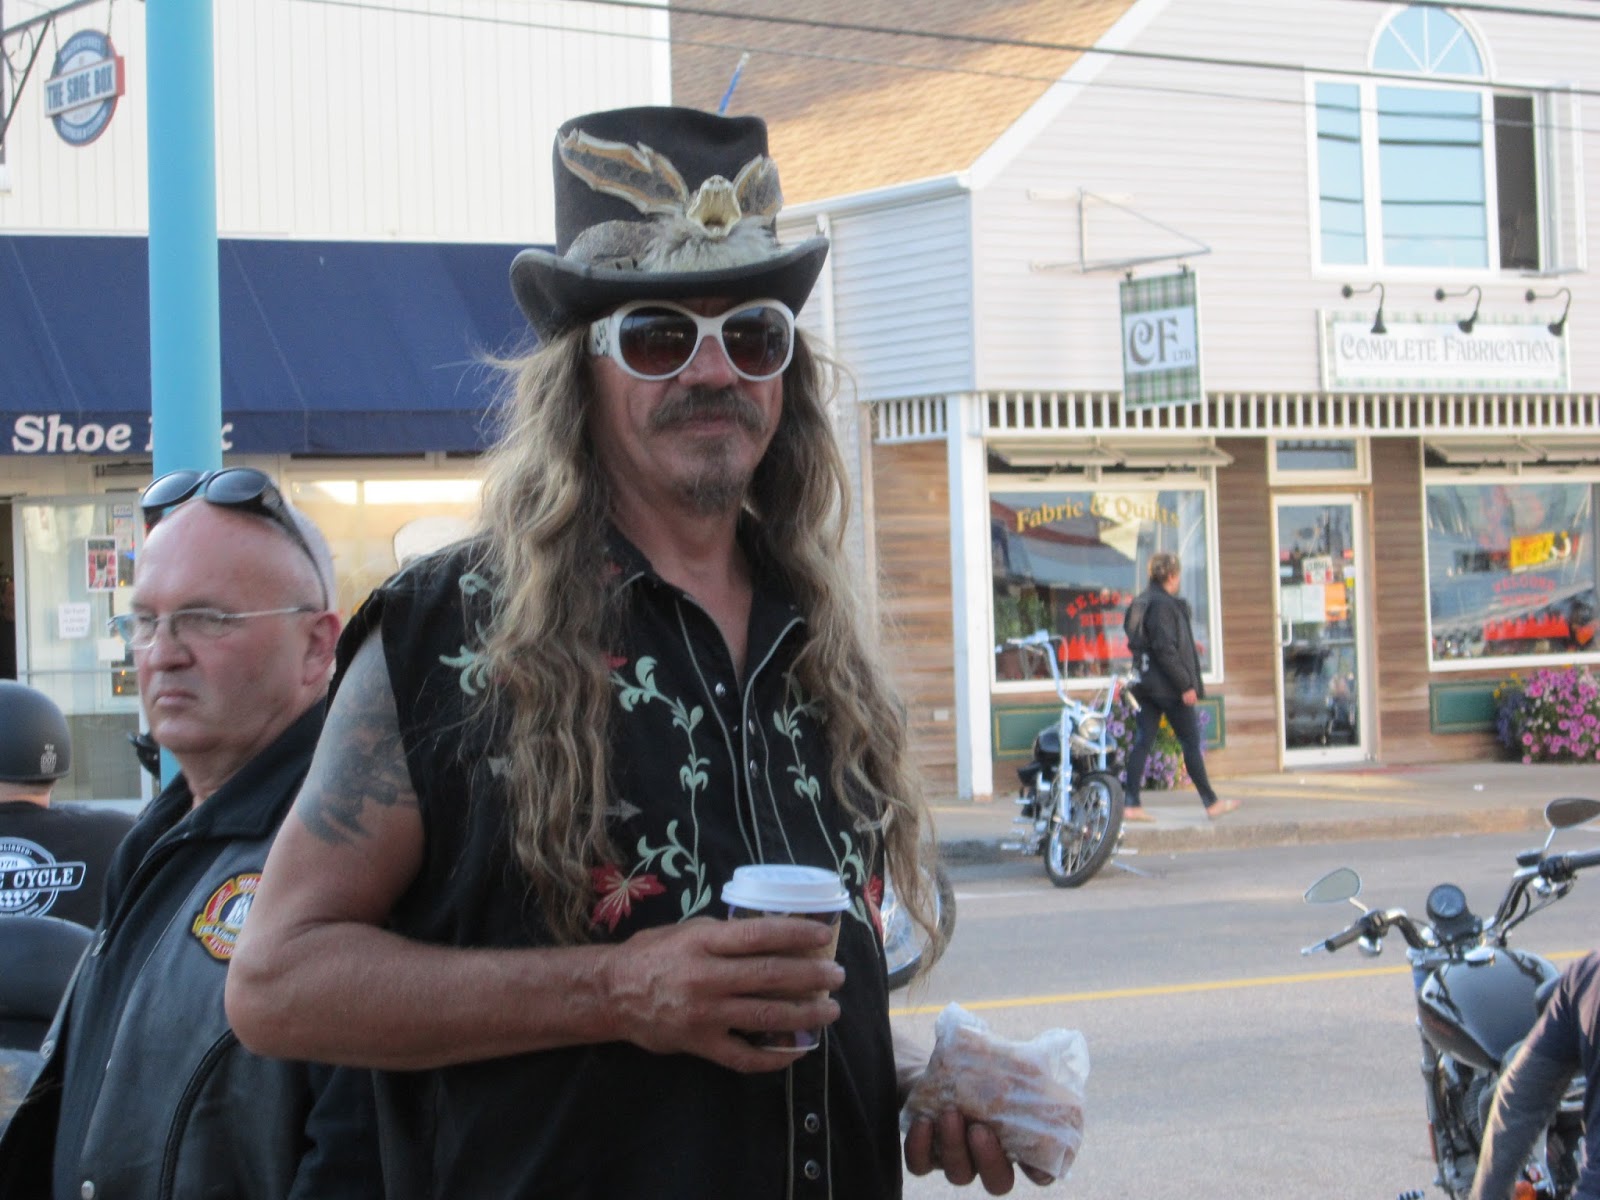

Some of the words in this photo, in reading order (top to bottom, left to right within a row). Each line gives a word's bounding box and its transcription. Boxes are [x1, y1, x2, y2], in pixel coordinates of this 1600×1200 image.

[46, 80, 63, 111] THE
[67, 71, 91, 104] SHOE
[94, 63, 113, 95] BOX
[1129, 315, 1178, 366] CF
[1340, 334, 1437, 361] COMPLETE
[1443, 335, 1556, 363] FABRICATION
[12, 414, 132, 453] Shoe
[1016, 497, 1083, 533] Fabric
[1090, 495, 1107, 517] &
[1115, 495, 1180, 528] Quilts
[1066, 591, 1134, 618] WELCOM
[13, 867, 74, 889] CYCLE
